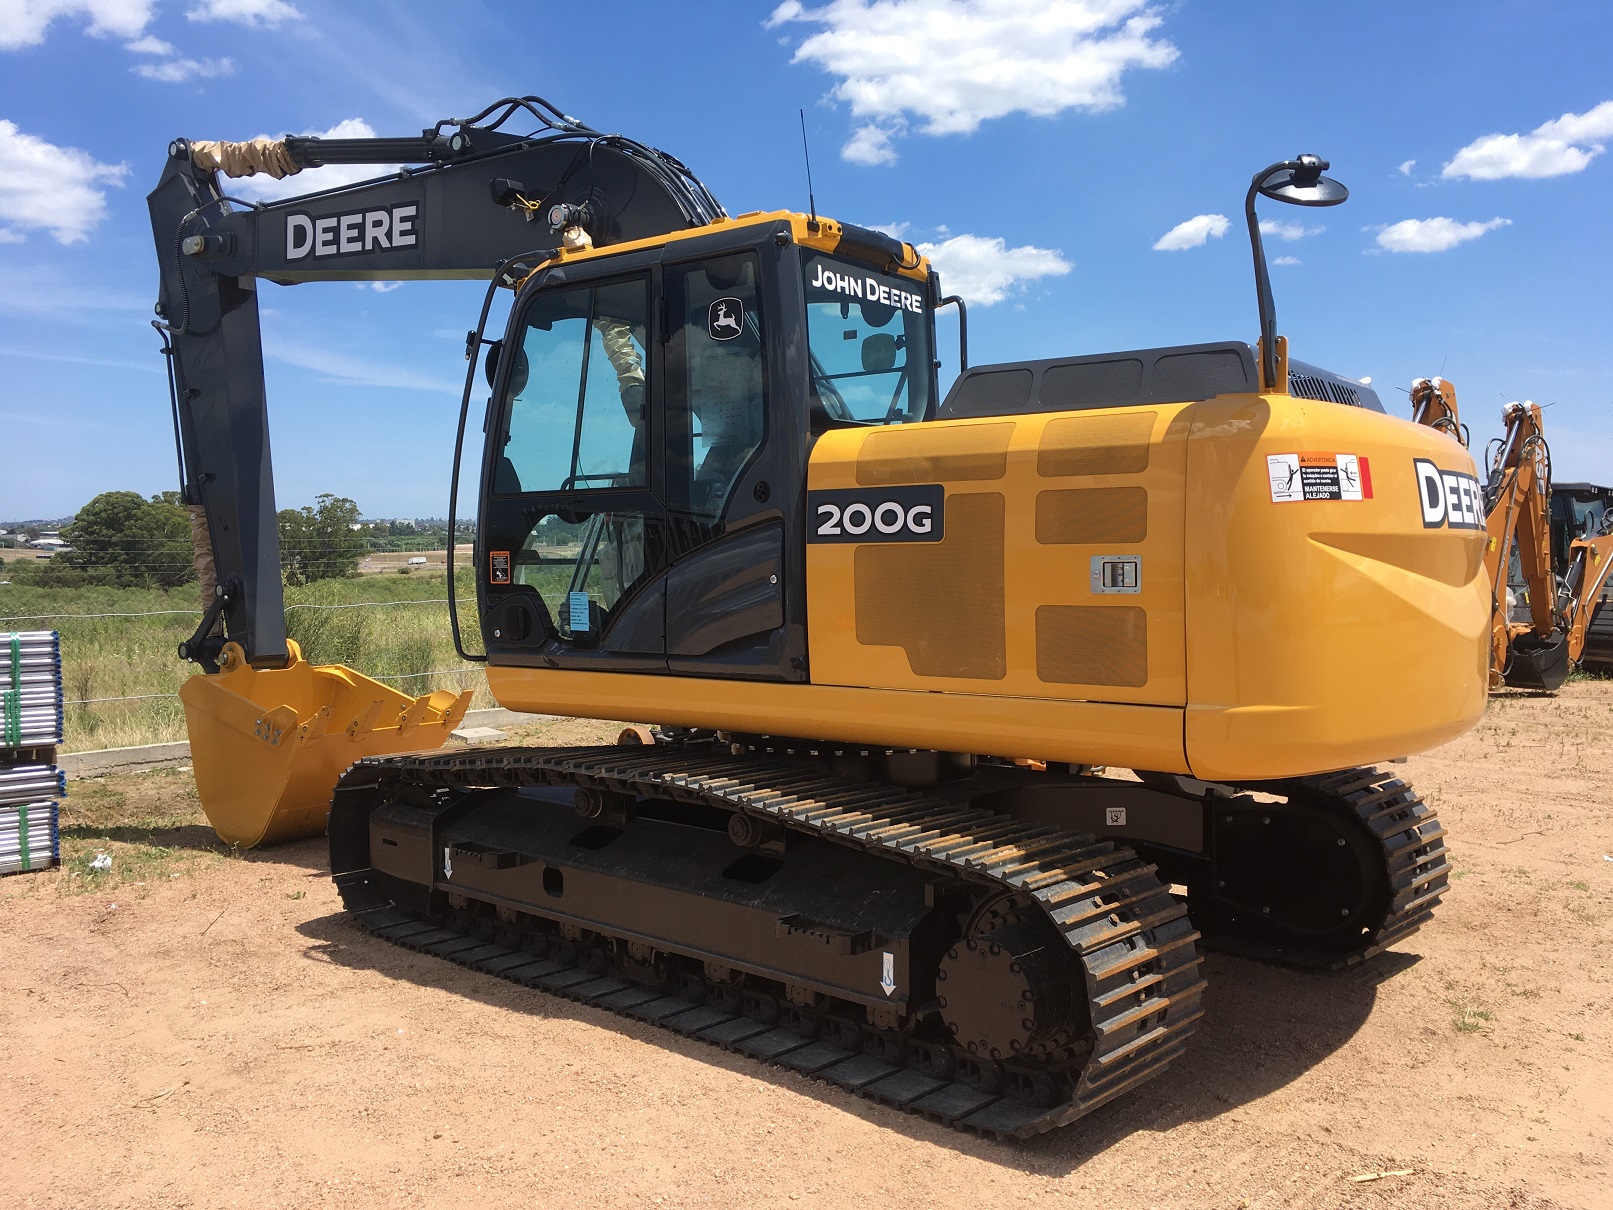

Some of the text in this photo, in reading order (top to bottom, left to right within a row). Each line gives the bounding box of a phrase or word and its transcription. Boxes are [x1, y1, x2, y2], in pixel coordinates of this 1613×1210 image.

[287, 205, 417, 260] DEERE
[812, 264, 923, 314] JOHN DEERE
[817, 501, 932, 535] 200G
